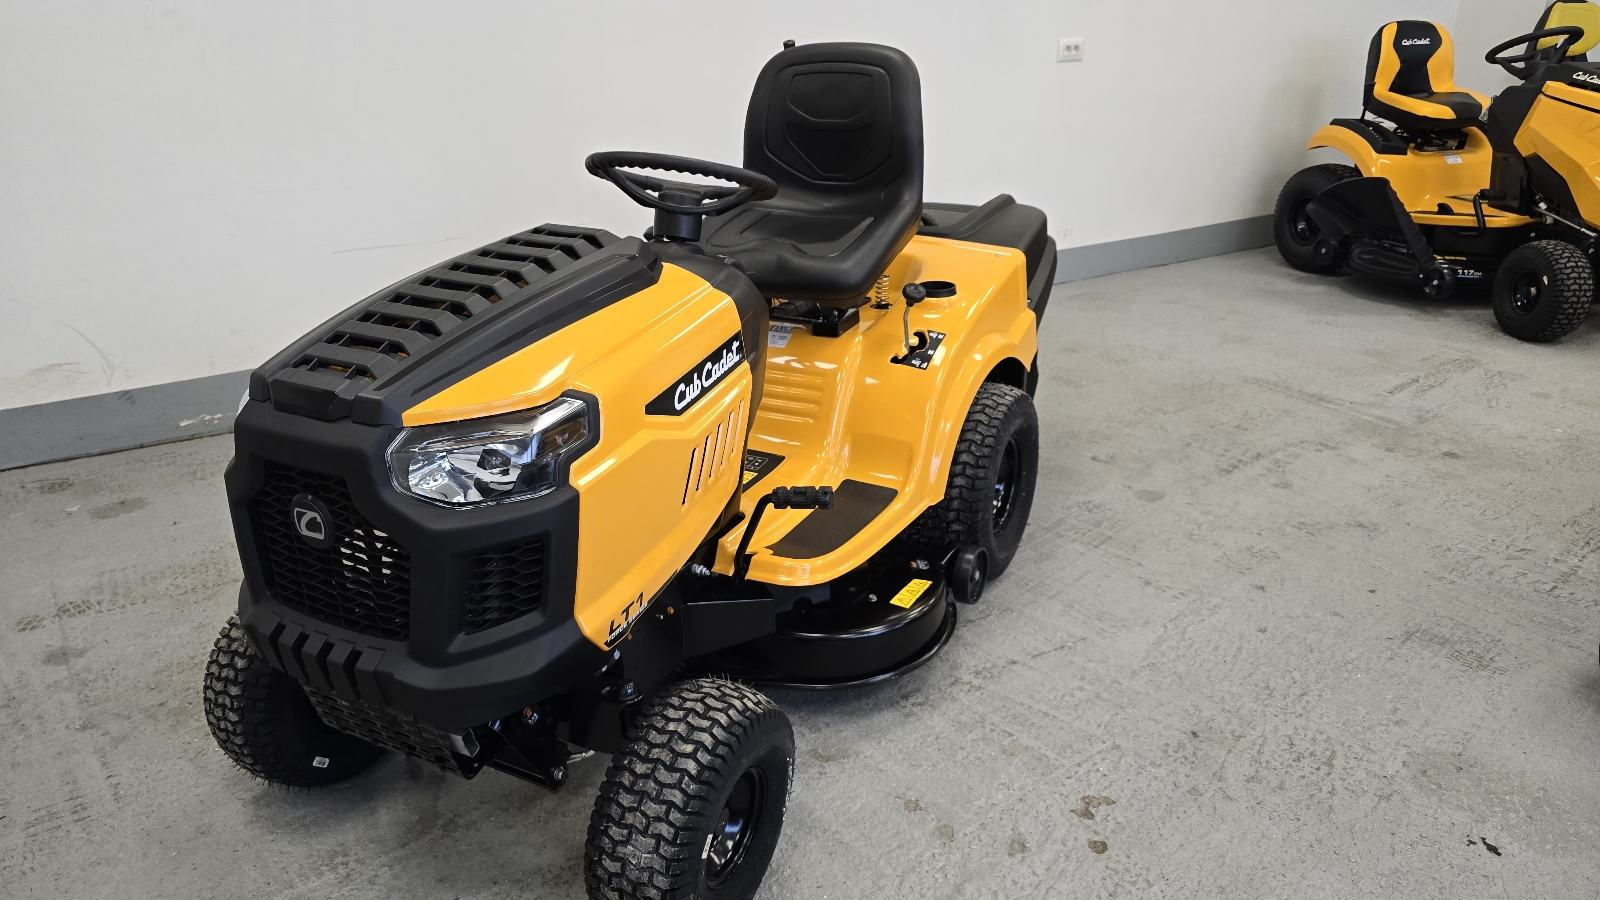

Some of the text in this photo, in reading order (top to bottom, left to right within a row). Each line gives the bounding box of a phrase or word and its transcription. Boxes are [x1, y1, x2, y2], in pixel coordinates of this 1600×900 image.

[1572, 71, 1589, 81] Cub
[674, 340, 741, 411] Cub Cadet
[608, 591, 644, 637] LT1
